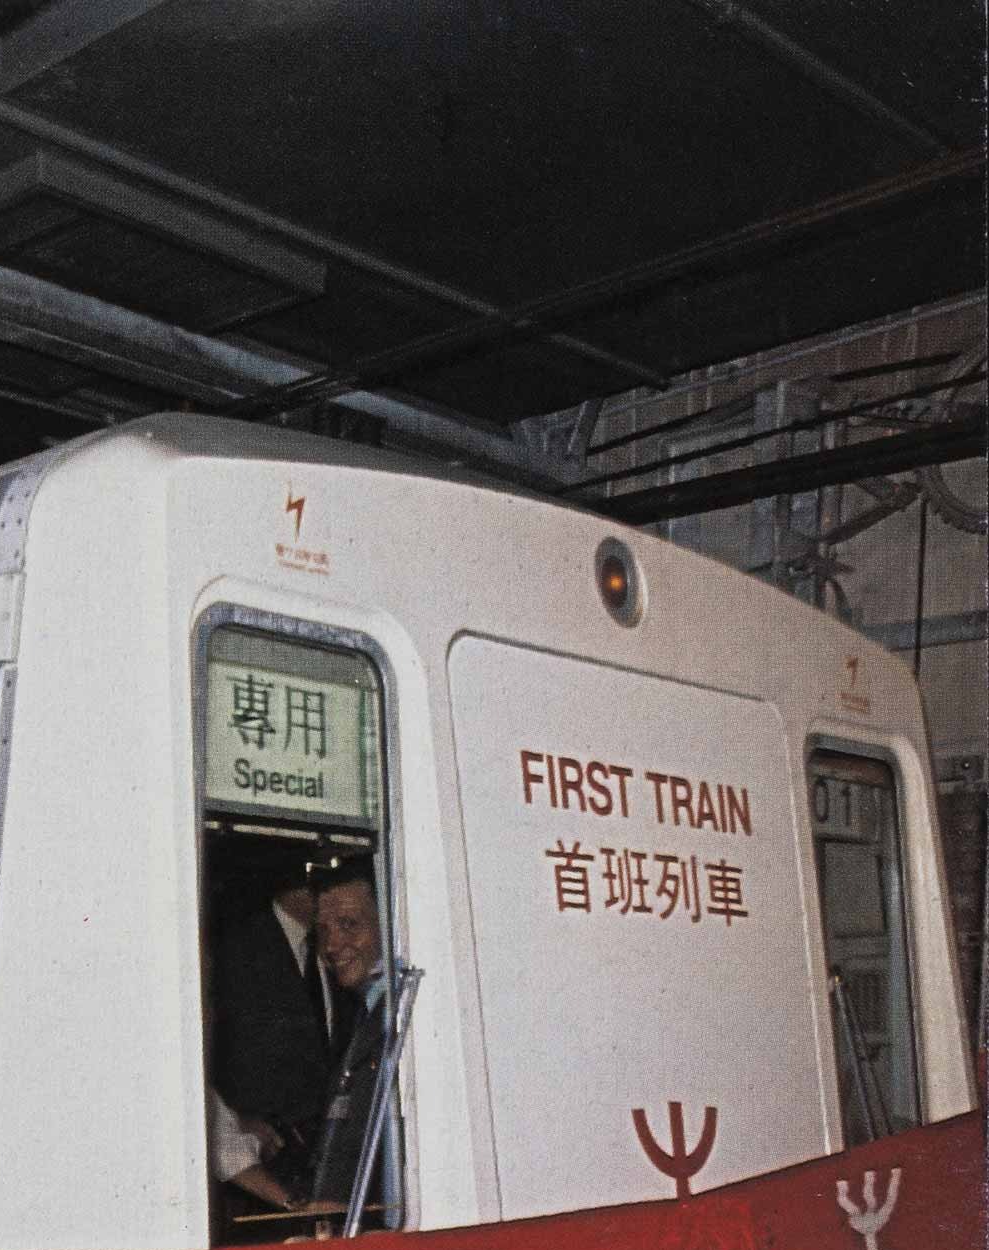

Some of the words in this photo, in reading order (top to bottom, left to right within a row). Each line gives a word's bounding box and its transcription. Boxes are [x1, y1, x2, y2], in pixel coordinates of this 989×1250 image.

[226, 674, 327, 759] 專用
[233, 757, 324, 799] Special
[520, 750, 633, 818] FIRST
[646, 771, 753, 837] TRAIN
[545, 840, 748, 927] 首班列車
